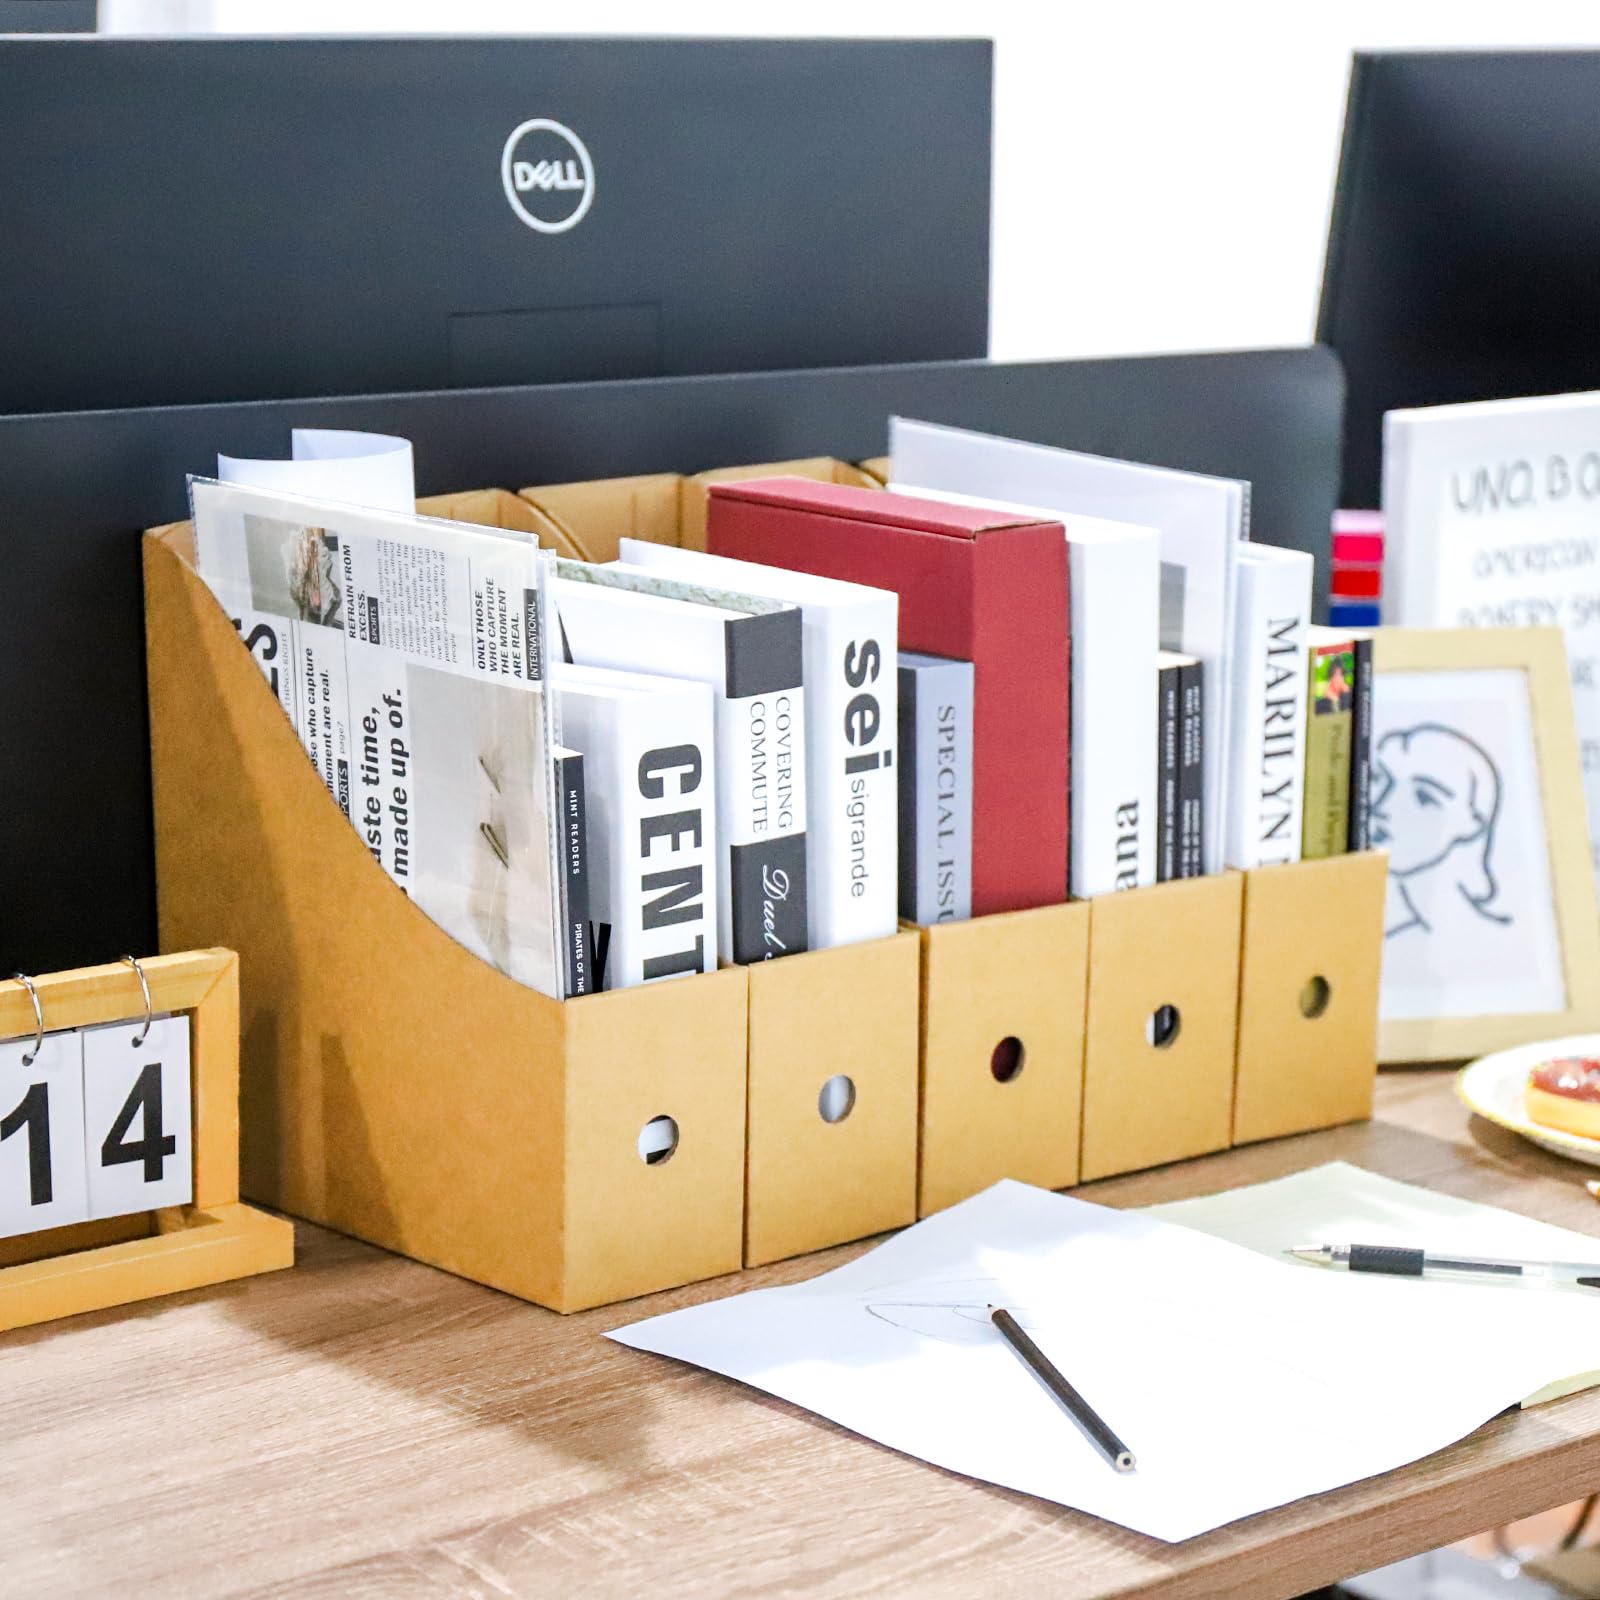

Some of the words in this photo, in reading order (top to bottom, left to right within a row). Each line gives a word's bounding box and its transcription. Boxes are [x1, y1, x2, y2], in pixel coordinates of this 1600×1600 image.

[513, 160, 585, 191] DELL
[342, 544, 352, 581] FROM
[346, 585, 356, 638] REFRAIN
[358, 590, 367, 641] EXCESS.
[370, 606, 378, 642] SPORTS
[475, 590, 484, 634] THOSE
[486, 577, 496, 638] CAPTURE
[498, 588, 508, 648] MOMENT
[510, 612, 520, 648] REAL.
[527, 600, 538, 678] INTERNATIONAL
[476, 636, 486, 670] ONLY
[488, 642, 498, 672] WHO
[500, 650, 510, 674] THE
[512, 651, 522, 678] ARE
[305, 648, 316, 704] capture
[320, 670, 330, 702] real.
[307, 709, 316, 737] who
[322, 706, 331, 730] are
[382, 689, 403, 729] of.
[844, 638, 893, 776] sei
[1258, 616, 1301, 842] MARILYN
[310, 742, 318, 772] ose
[360, 707, 380, 786] time,
[390, 738, 410, 778] up
[750, 701, 768, 833] COMMUTE
[775, 696, 793, 829] COVERING
[938, 705, 956, 849] SPECIAL
[569, 790, 578, 818] MINT
[389, 787, 409, 877] made
[570, 824, 580, 875] READERS
[847, 778, 870, 899] sigrande
[638, 743, 704, 982] CENT
[761, 864, 790, 947] Duel
[574, 923, 583, 960] PIRATES
[576, 962, 584, 975] OF
